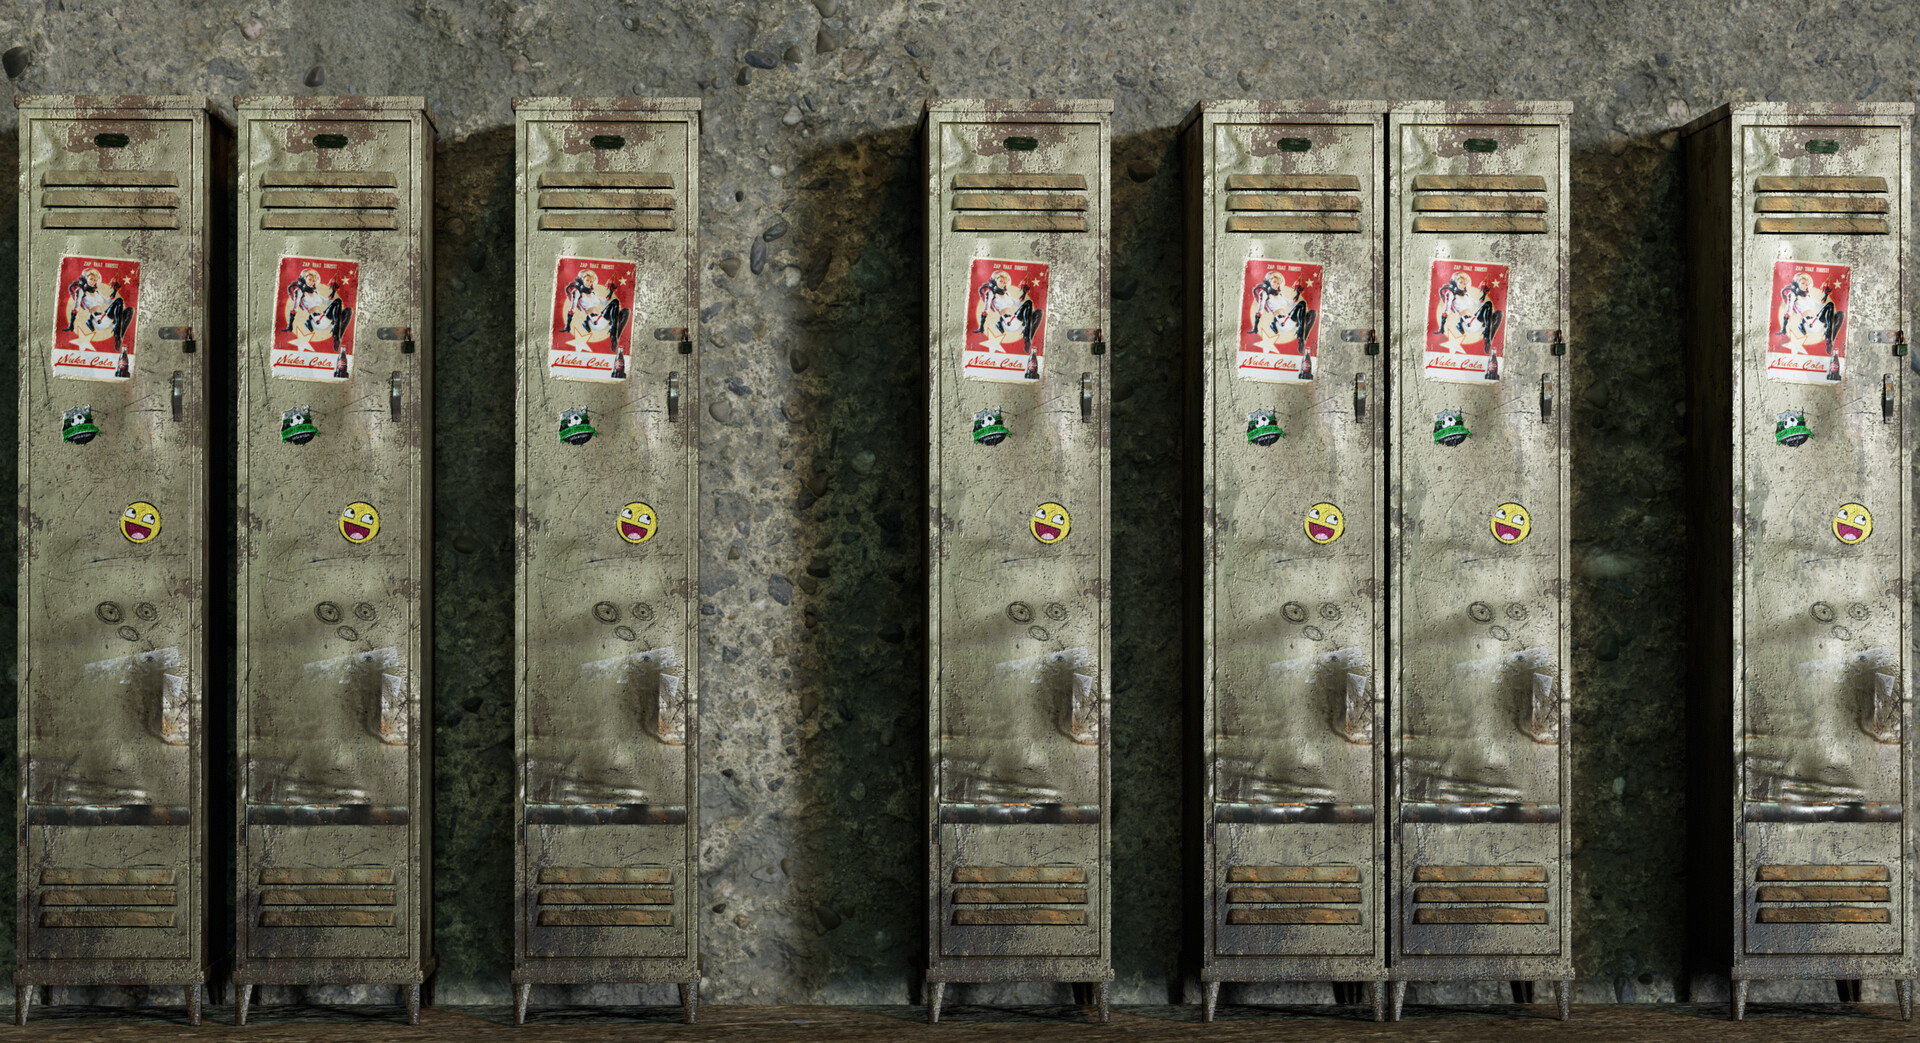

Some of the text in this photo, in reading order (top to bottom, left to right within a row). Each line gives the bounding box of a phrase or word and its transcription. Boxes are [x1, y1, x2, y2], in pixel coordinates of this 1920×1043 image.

[58, 354, 86, 364] Nuka
[90, 356, 113, 366] Cola
[277, 354, 304, 364] Nuka
[309, 357, 332, 367] Cola
[554, 354, 582, 365] Nuka
[587, 357, 609, 367] Cola
[968, 355, 996, 366] Nuka
[1000, 358, 1022, 368] Cola
[1242, 356, 1270, 366] Nuka
[1274, 359, 1296, 368] Cola
[1429, 356, 1456, 366] Nuka
[1461, 359, 1483, 368] Cola
[1771, 357, 1798, 367] Nuka
[1803, 360, 1824, 369] Cola
